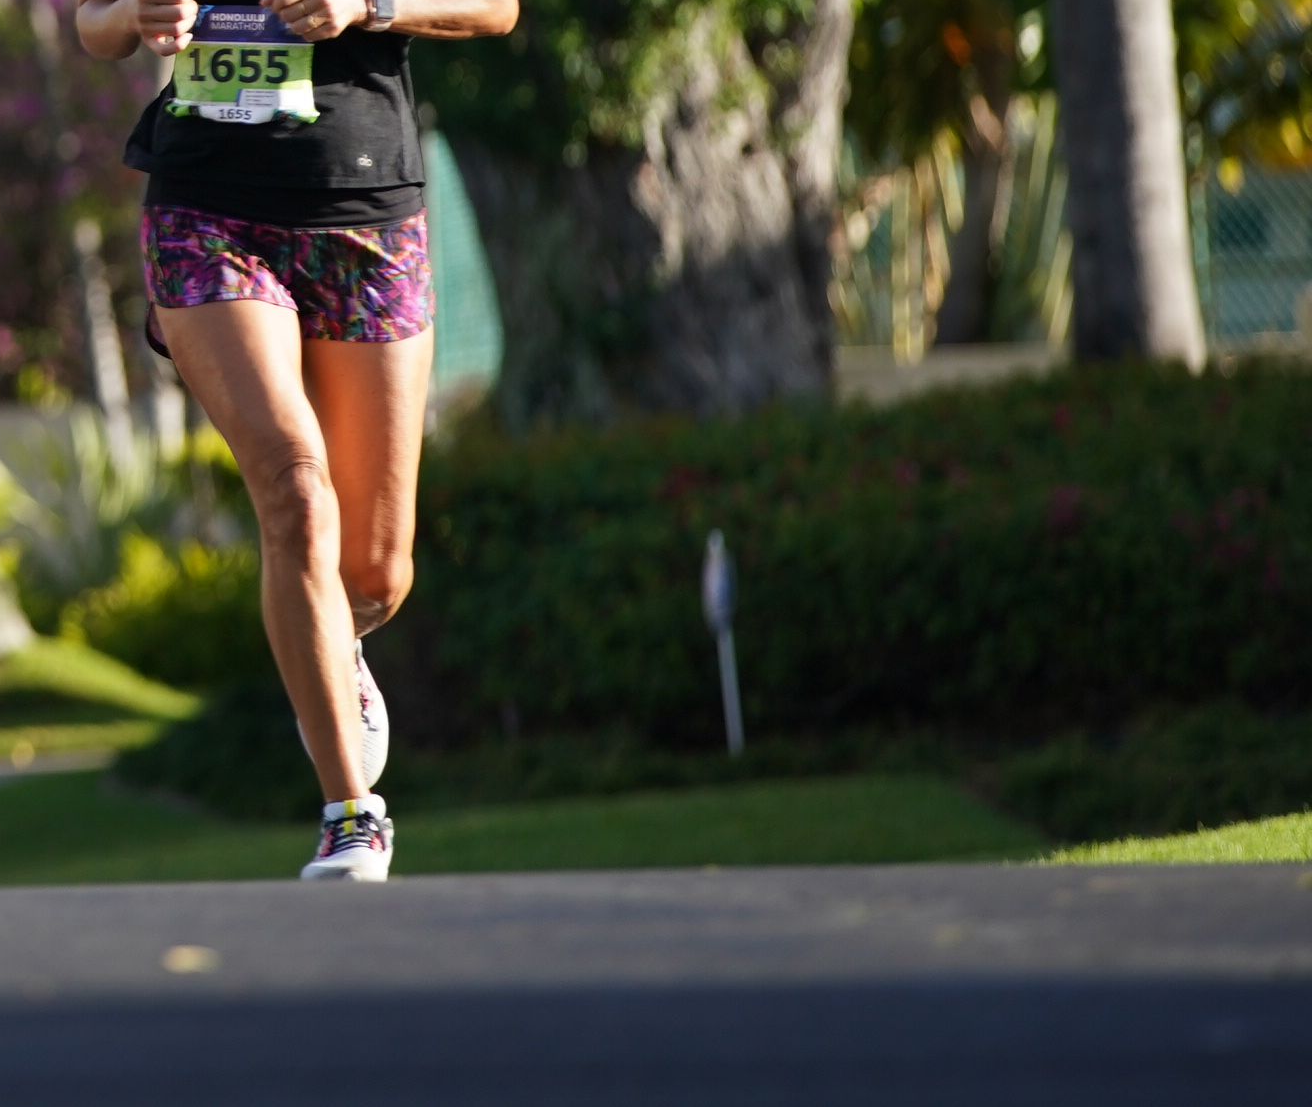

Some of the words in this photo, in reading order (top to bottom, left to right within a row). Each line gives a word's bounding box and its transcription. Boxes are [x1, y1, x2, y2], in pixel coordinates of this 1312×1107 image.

[211, 13, 265, 22] HONOLULU
[211, 22, 265, 31] MARATHON
[189, 48, 289, 83] 1655
[218, 108, 252, 120] 1655
